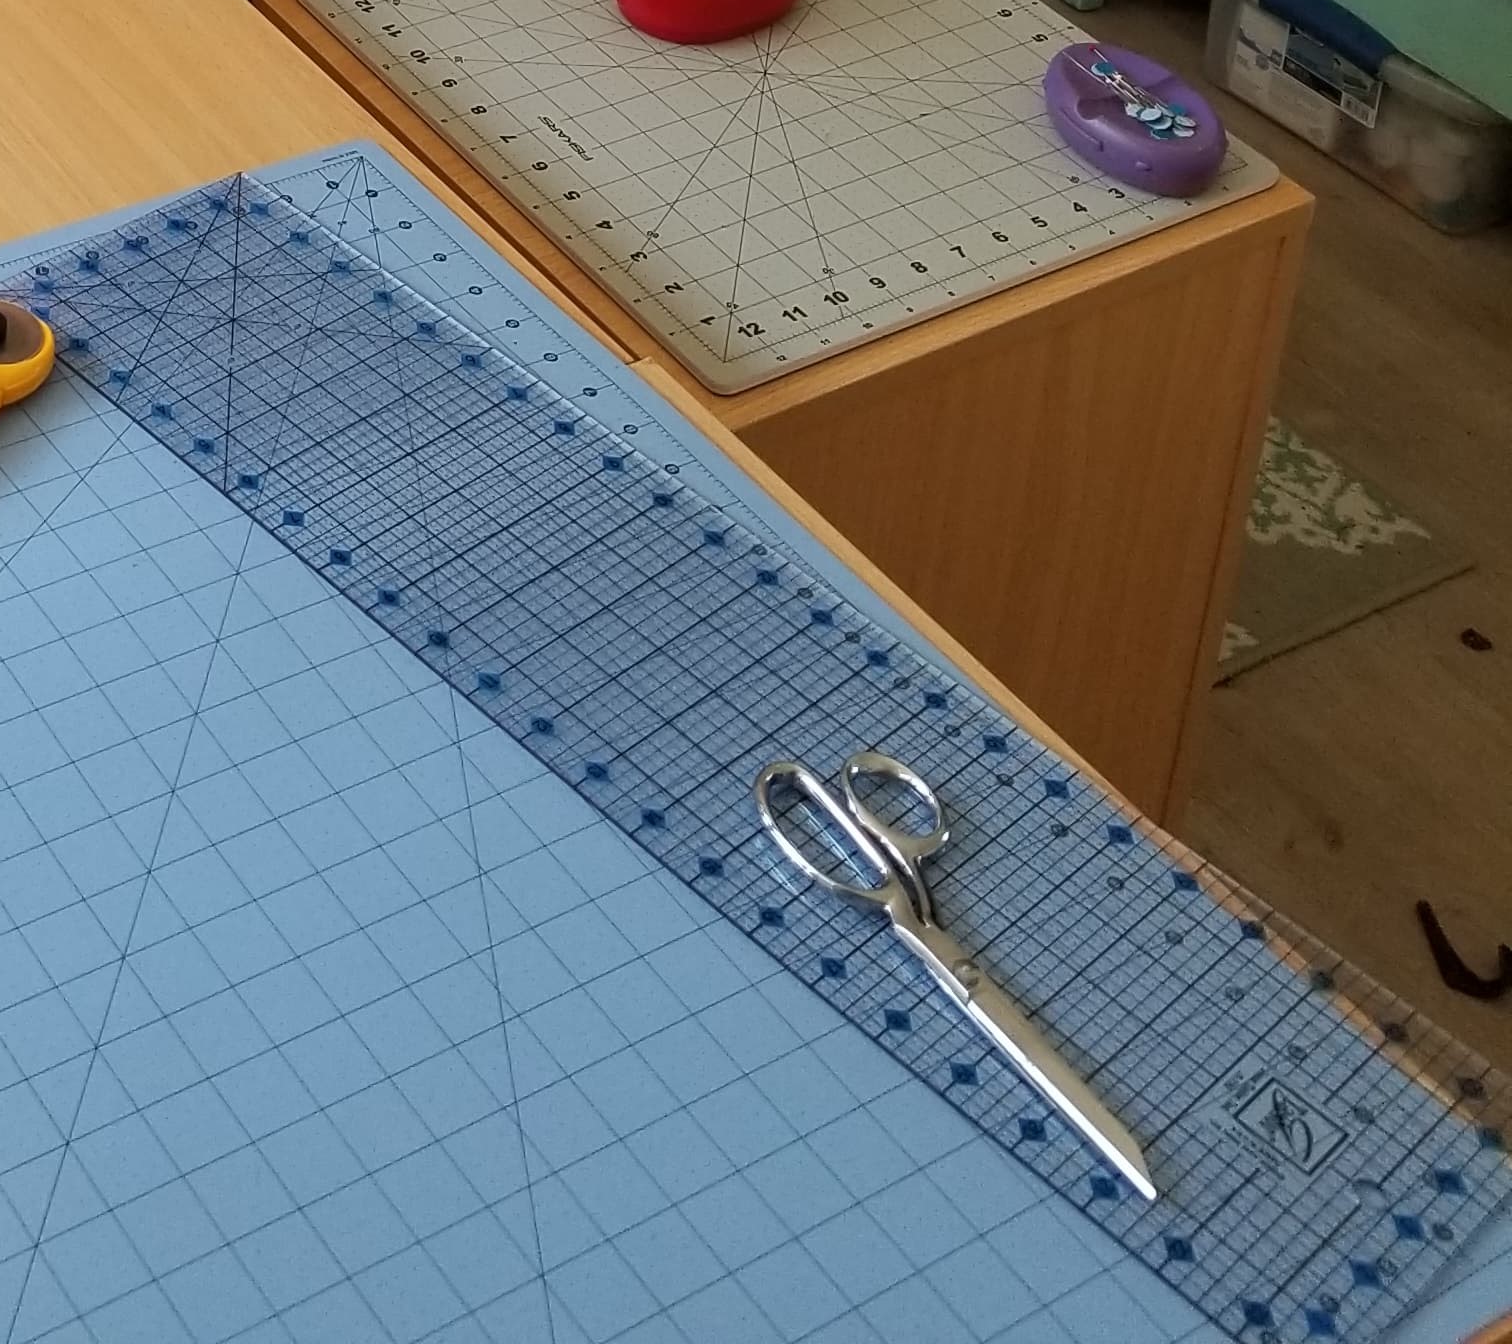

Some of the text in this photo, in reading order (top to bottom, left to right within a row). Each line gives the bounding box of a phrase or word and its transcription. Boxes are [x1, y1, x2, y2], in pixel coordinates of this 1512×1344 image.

[382, 23, 402, 39] 11
[410, 49, 431, 65] 10
[537, 115, 595, 162] FISKARS
[1073, 202, 1088, 213] 4
[1030, 216, 1048, 228] 5
[991, 231, 1009, 243] 6
[949, 245, 967, 258] 7
[910, 261, 928, 274] 8
[868, 277, 887, 289] 9
[823, 290, 850, 306] 10
[782, 305, 809, 322] 11
[737, 321, 766, 338] 12
